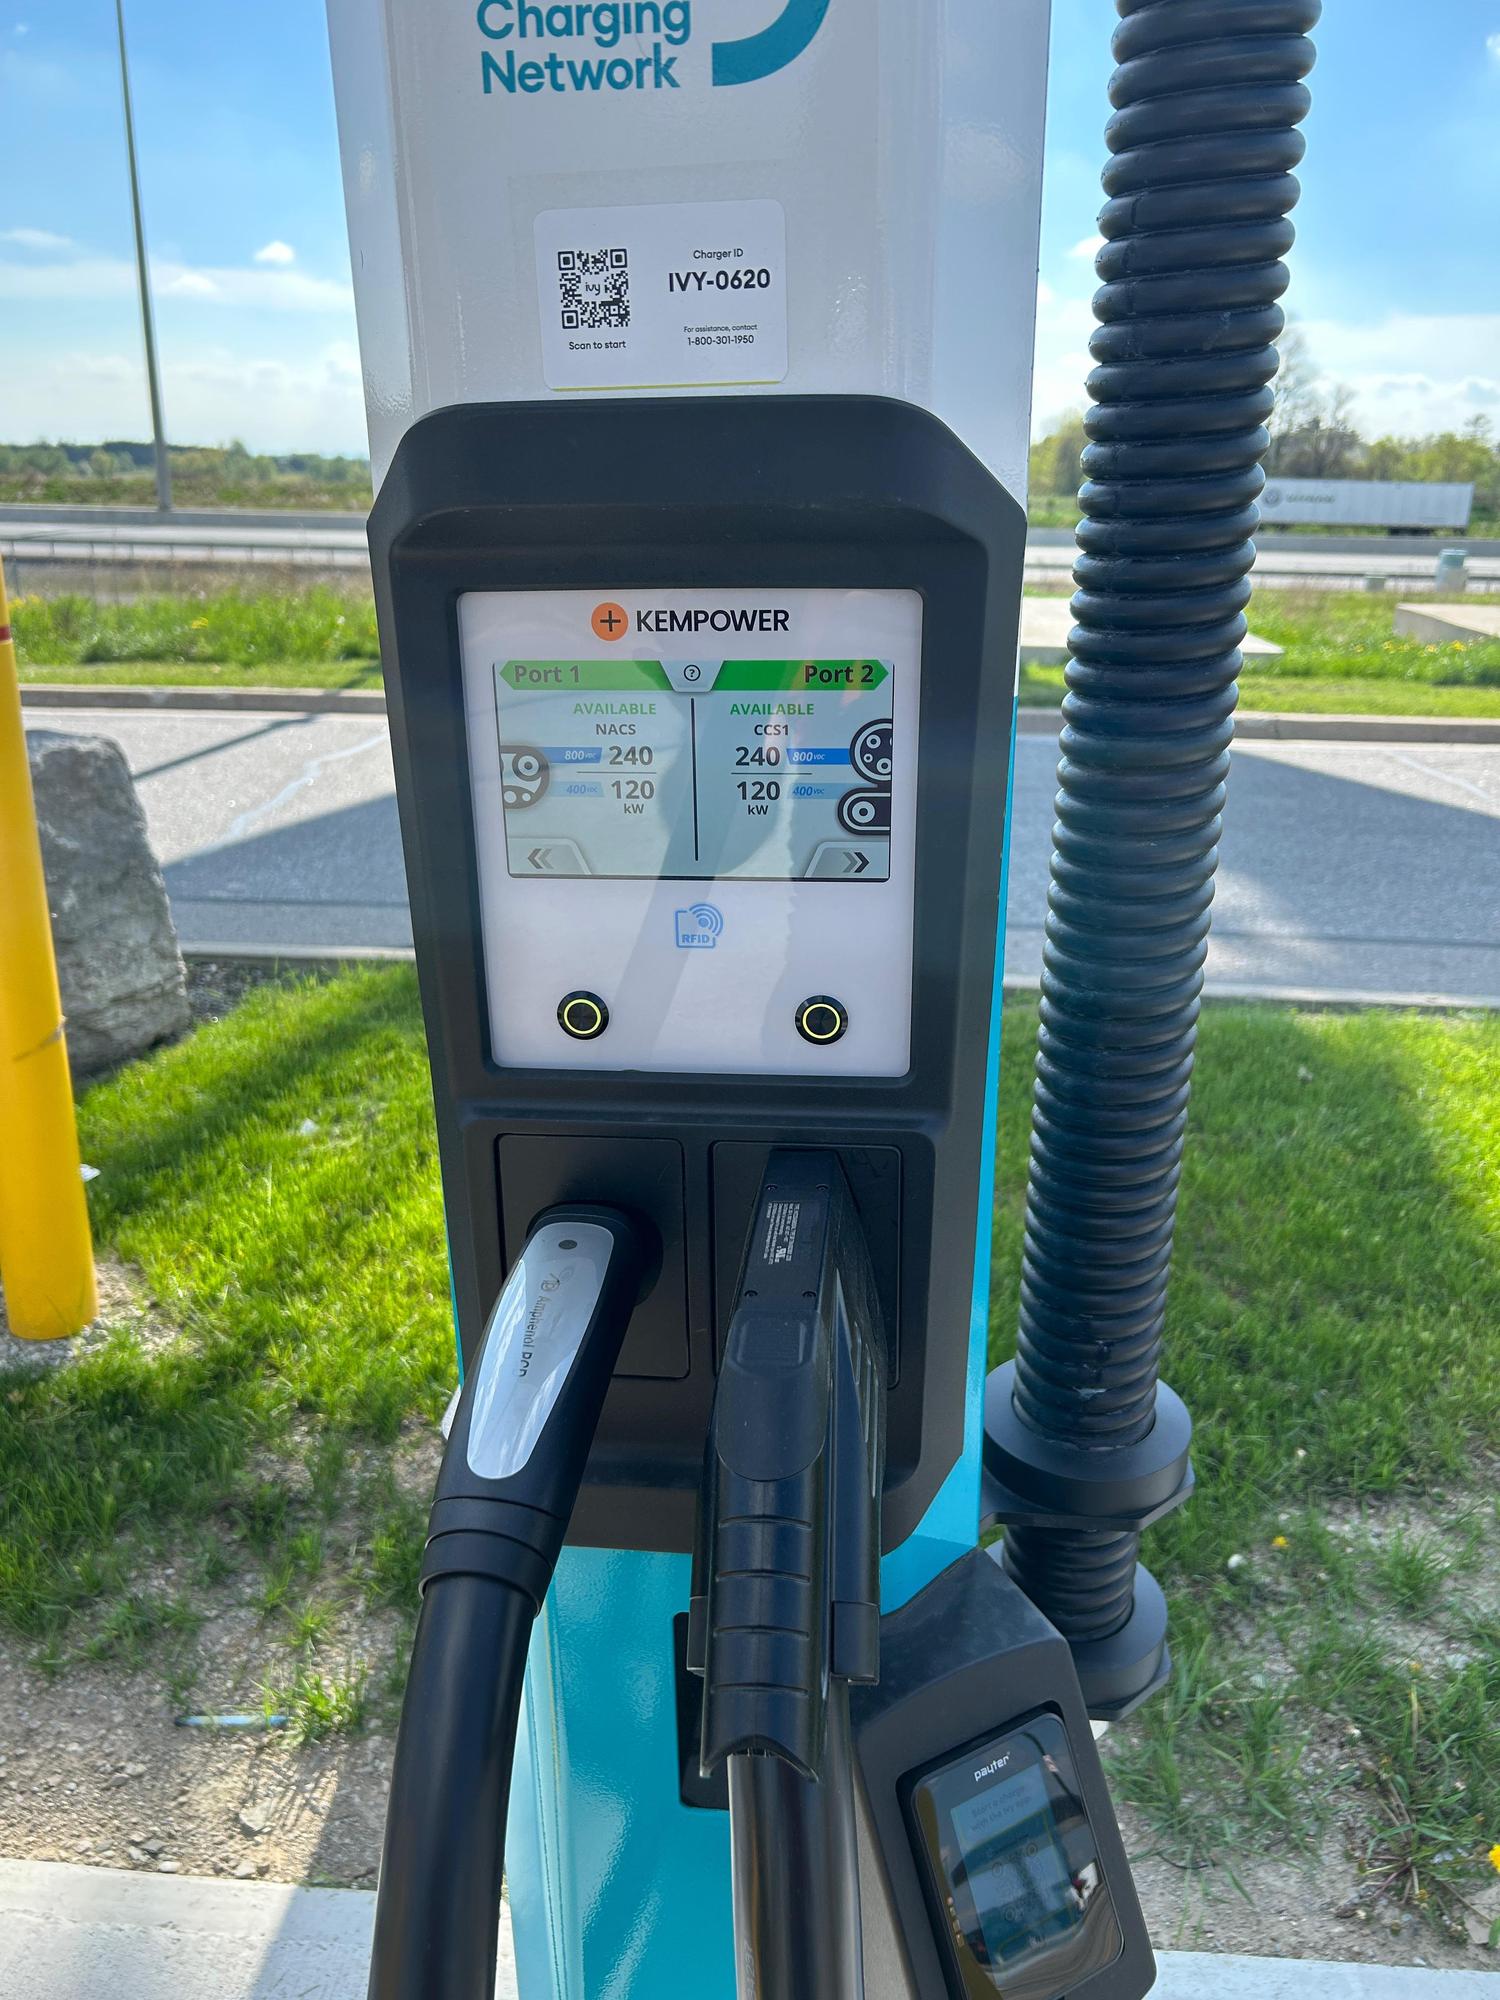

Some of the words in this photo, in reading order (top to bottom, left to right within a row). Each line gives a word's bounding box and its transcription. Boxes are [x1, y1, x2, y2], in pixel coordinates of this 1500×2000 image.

[477, 0, 691, 48] Charging
[481, 42, 680, 94] Network
[693, 249, 732, 260] Charger
[733, 248, 744, 258] ID
[669, 268, 771, 292] IVY-0620
[585, 282, 600, 296] ivy
[695, 325, 731, 333] assistance,
[569, 341, 591, 350] Scan
[593, 341, 603, 349] to
[604, 340, 626, 349] start
[687, 335, 754, 346] 1-800-301-1950
[637, 609, 790, 633] KEMPOWER
[514, 665, 562, 683] Port
[570, 665, 580, 683] 1
[805, 665, 854, 683] Port
[861, 664, 874, 683] 2
[573, 703, 657, 715] AVAILABLE
[730, 703, 815, 715] AVAILABLE
[595, 723, 636, 736] NACS
[754, 724, 789, 736] CCS1
[608, 745, 653, 766] 240
[735, 746, 780, 767] 240
[611, 780, 655, 800] 120
[736, 780, 781, 801] 120
[623, 803, 645, 814] kW
[747, 804, 769, 815] kW
[681, 934, 710, 944] RFID
[523, 1295, 552, 1348] Amphenol
[974, 1755, 1010, 1782] payter
